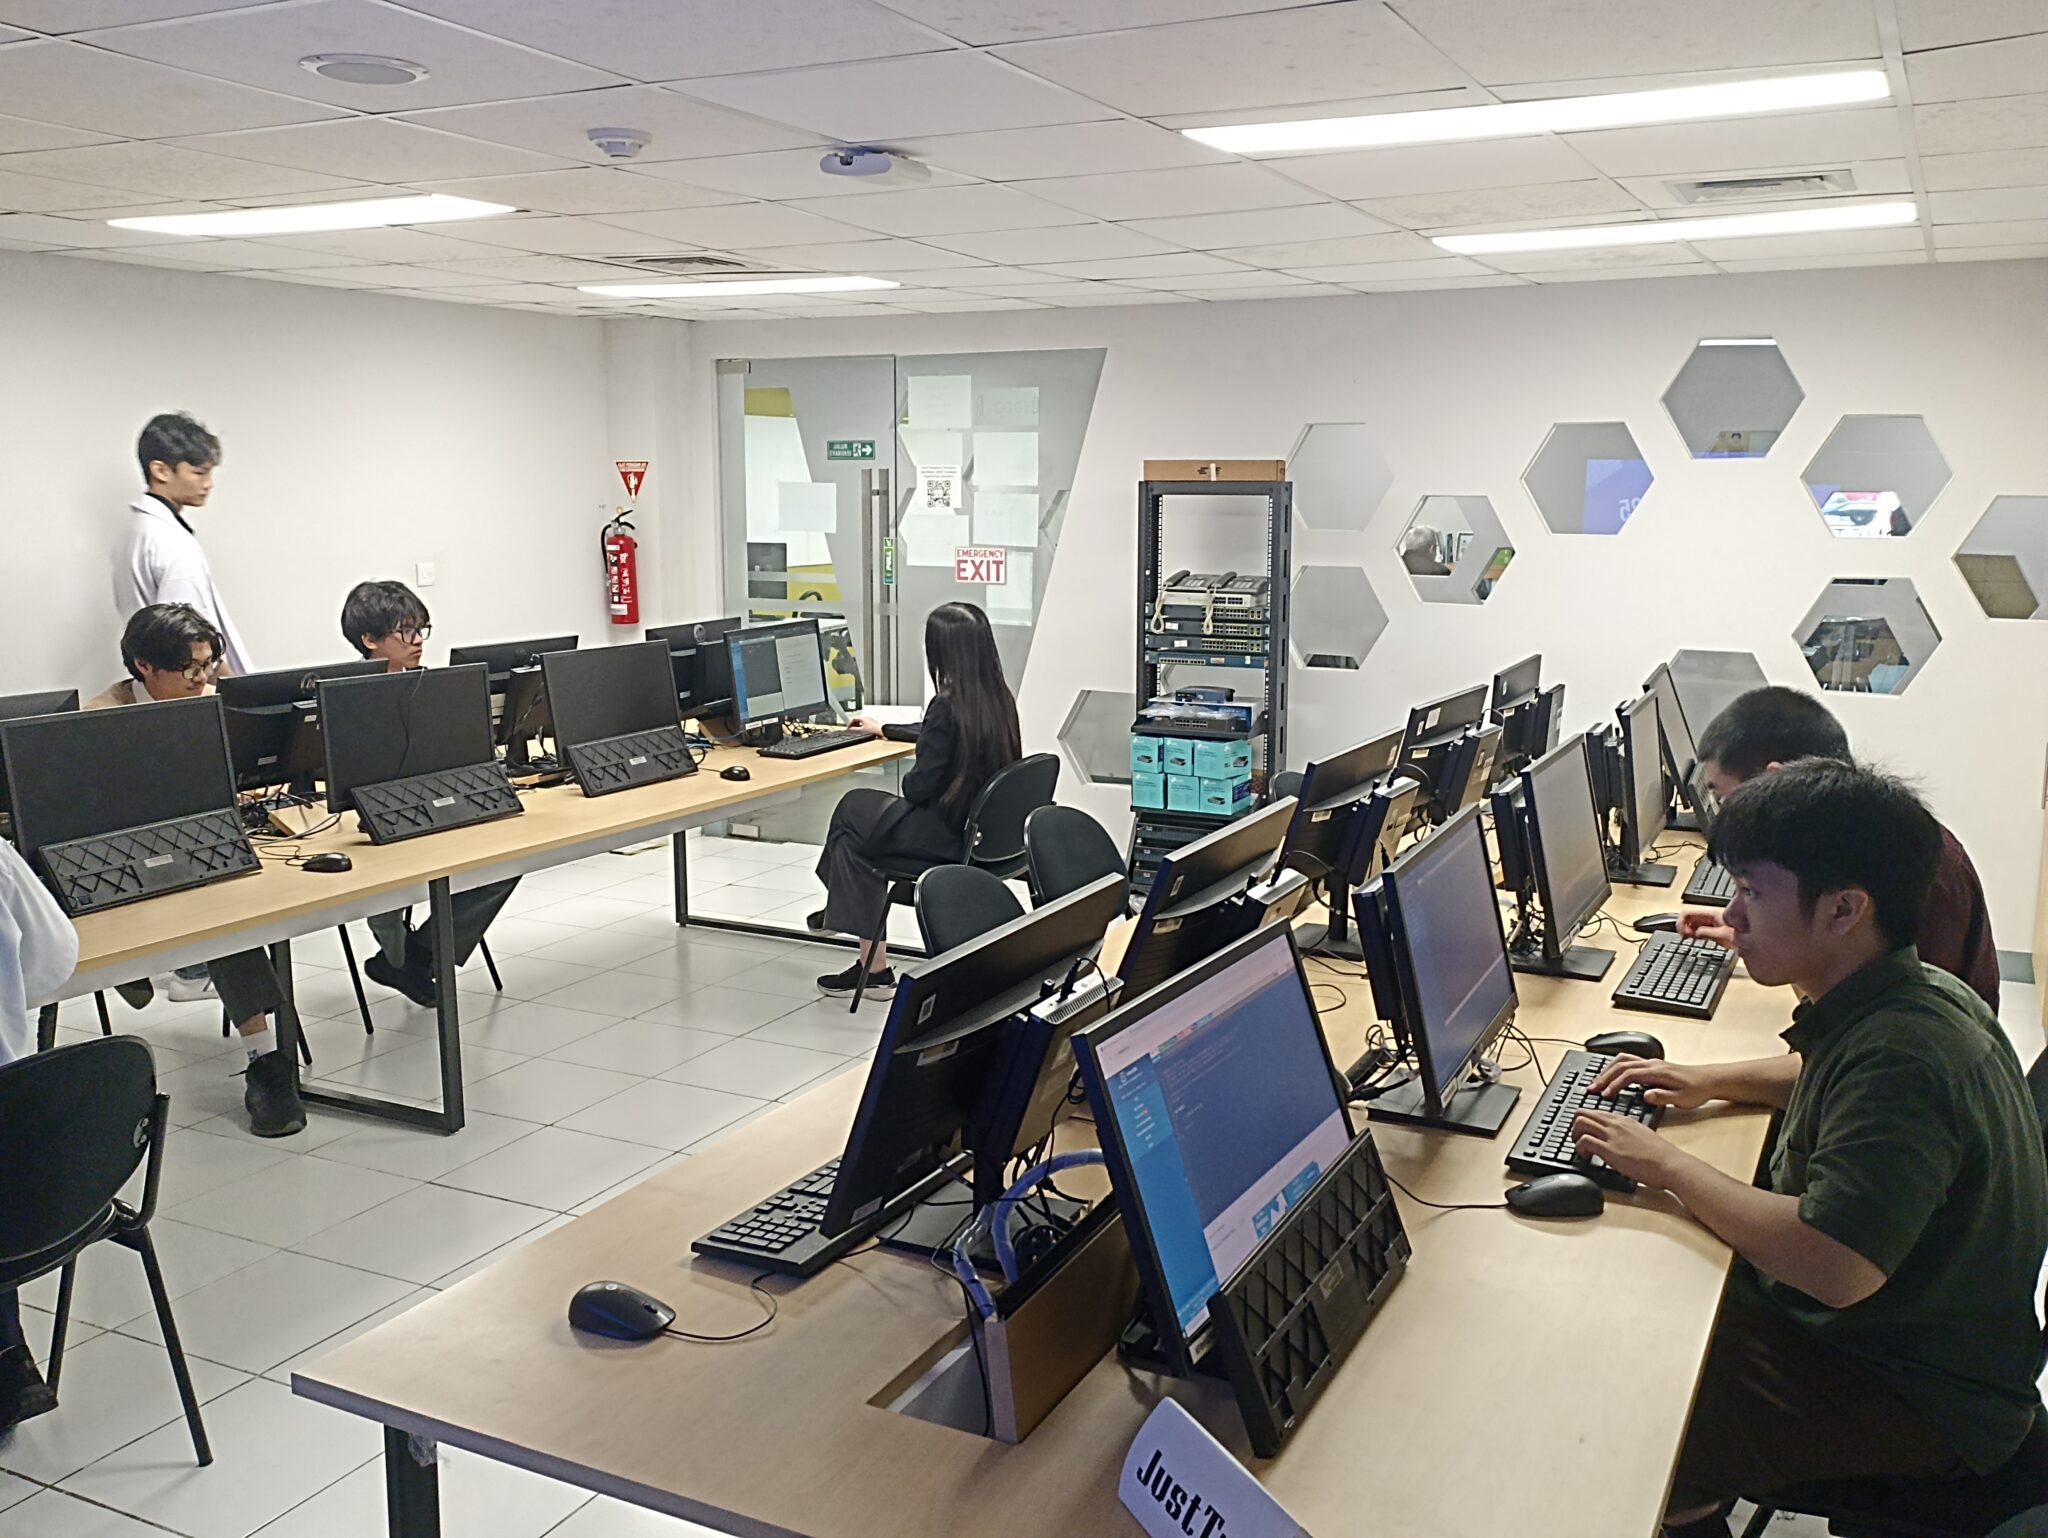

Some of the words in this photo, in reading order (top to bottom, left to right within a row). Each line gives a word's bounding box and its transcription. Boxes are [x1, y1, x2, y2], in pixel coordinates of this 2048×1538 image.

[957, 549, 1004, 558] EMERGENCY
[957, 559, 1004, 582] EXIT
[1136, 1449, 1227, 1538] JustT
